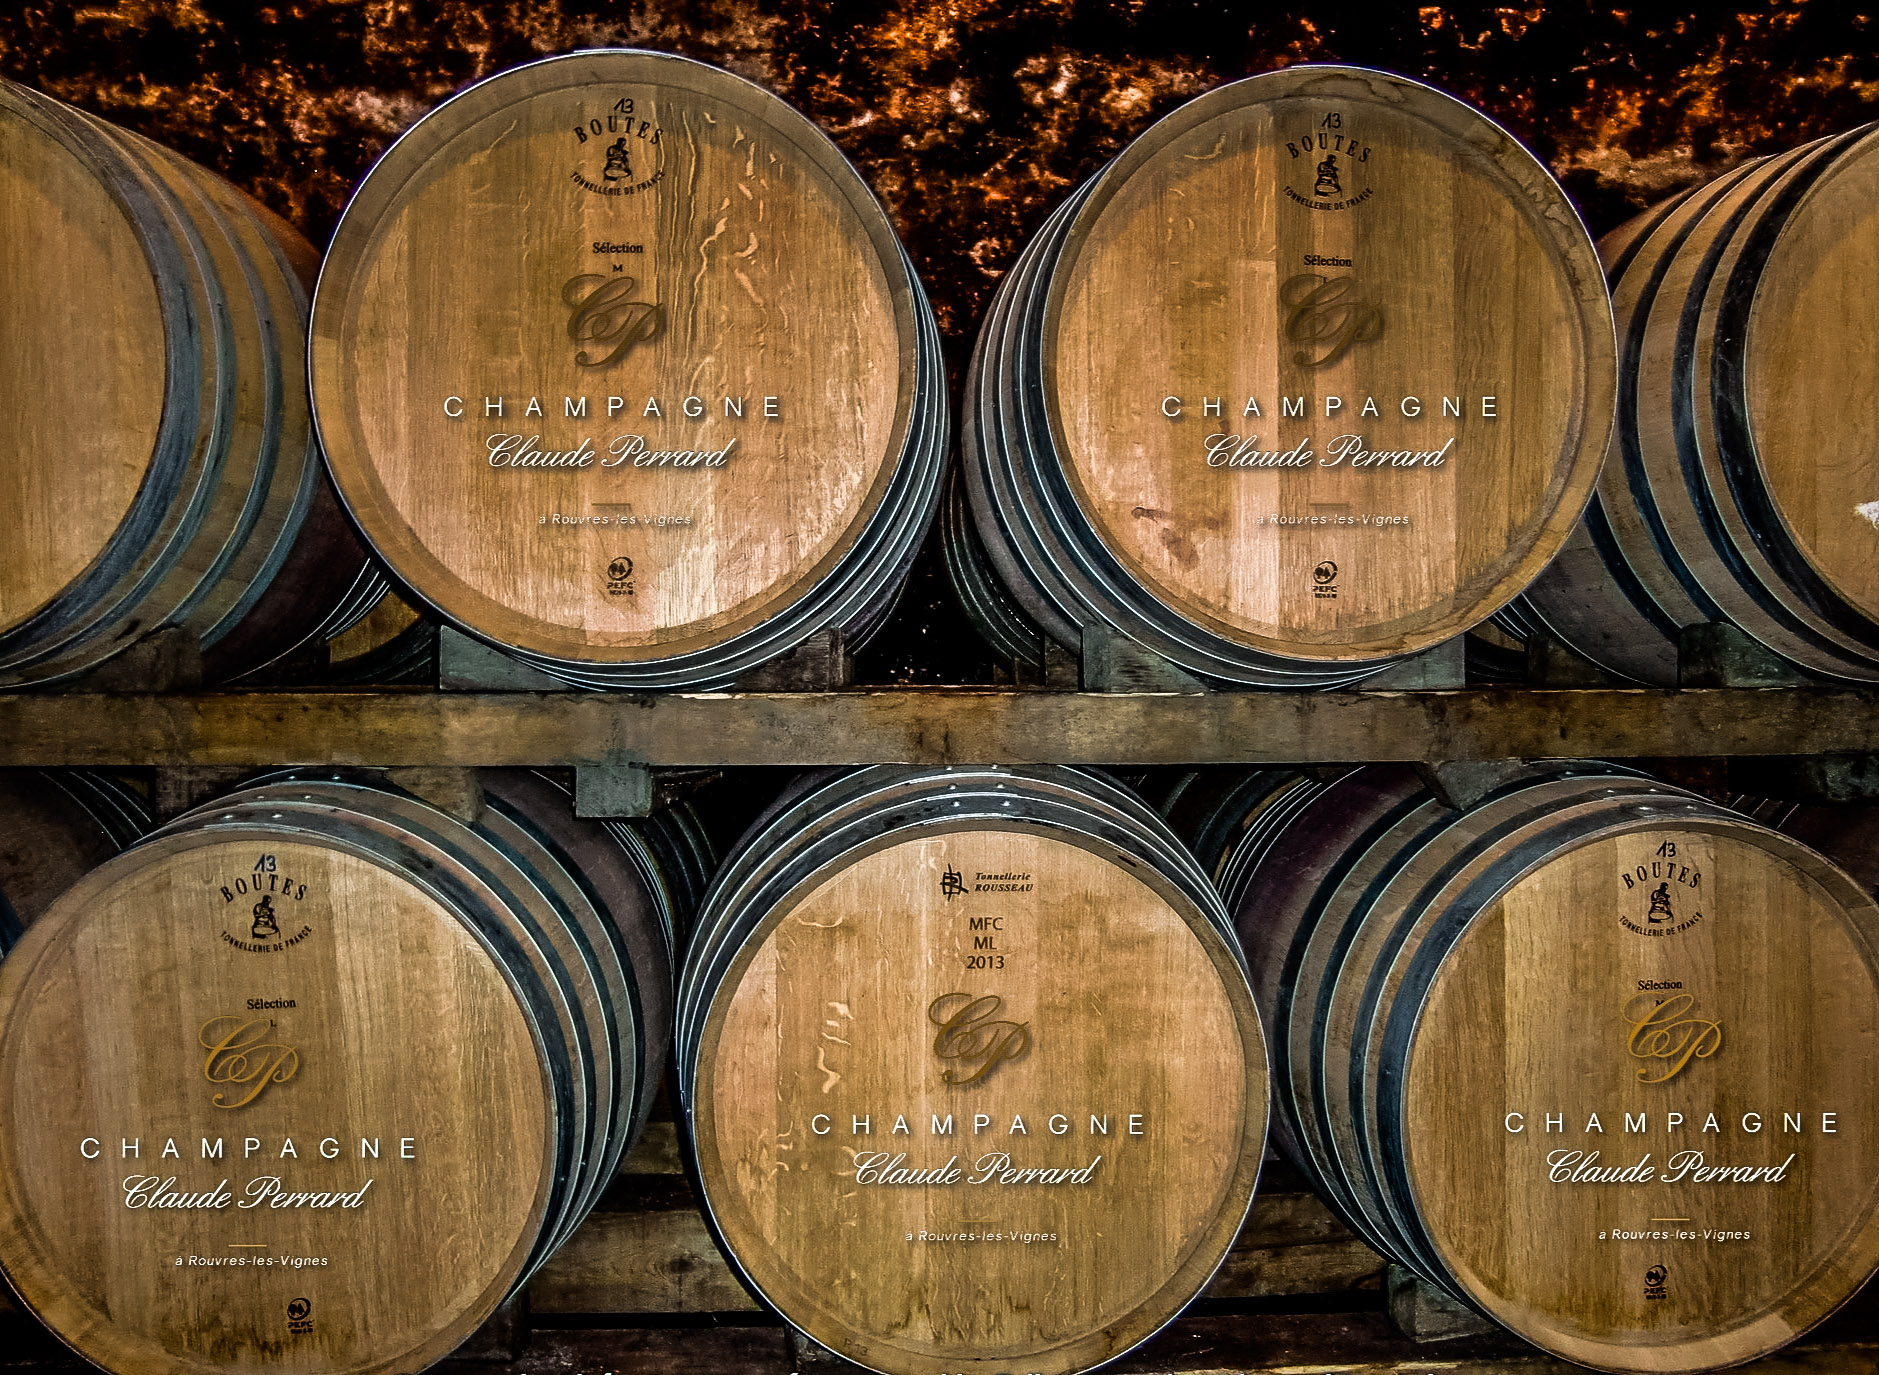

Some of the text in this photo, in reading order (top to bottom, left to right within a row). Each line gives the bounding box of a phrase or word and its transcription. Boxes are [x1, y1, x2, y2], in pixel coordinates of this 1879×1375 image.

[614, 98, 634, 113] 13
[1321, 113, 1341, 129] 13
[573, 115, 664, 144] BOUTES
[1286, 133, 1371, 162] BOUTES
[570, 171, 621, 196] TONNELLERIE
[624, 186, 635, 195] DE
[1283, 185, 1332, 210] TONNELLERIE
[1334, 202, 1345, 210] DE
[592, 242, 644, 254] Sélection
[1303, 254, 1352, 267] Sélection
[1656, 840, 1676, 857] 13
[254, 853, 277, 872] 13
[975, 872, 1031, 880] Tonnellerie
[1622, 862, 1701, 889] BOUTES
[220, 873, 307, 903] BOUTES
[974, 883, 1034, 892] ROUSSEAU
[969, 917, 1004, 931] MFC
[1618, 916, 1664, 936] TONNELLERIE
[1666, 927, 1676, 935] DE
[220, 931, 271, 954] TONNELLERIE
[273, 943, 283, 951] DE
[973, 936, 998, 950] ML
[966, 955, 1005, 969] 2013
[1637, 979, 1682, 991] Sélection
[246, 997, 297, 1010] Sélection
